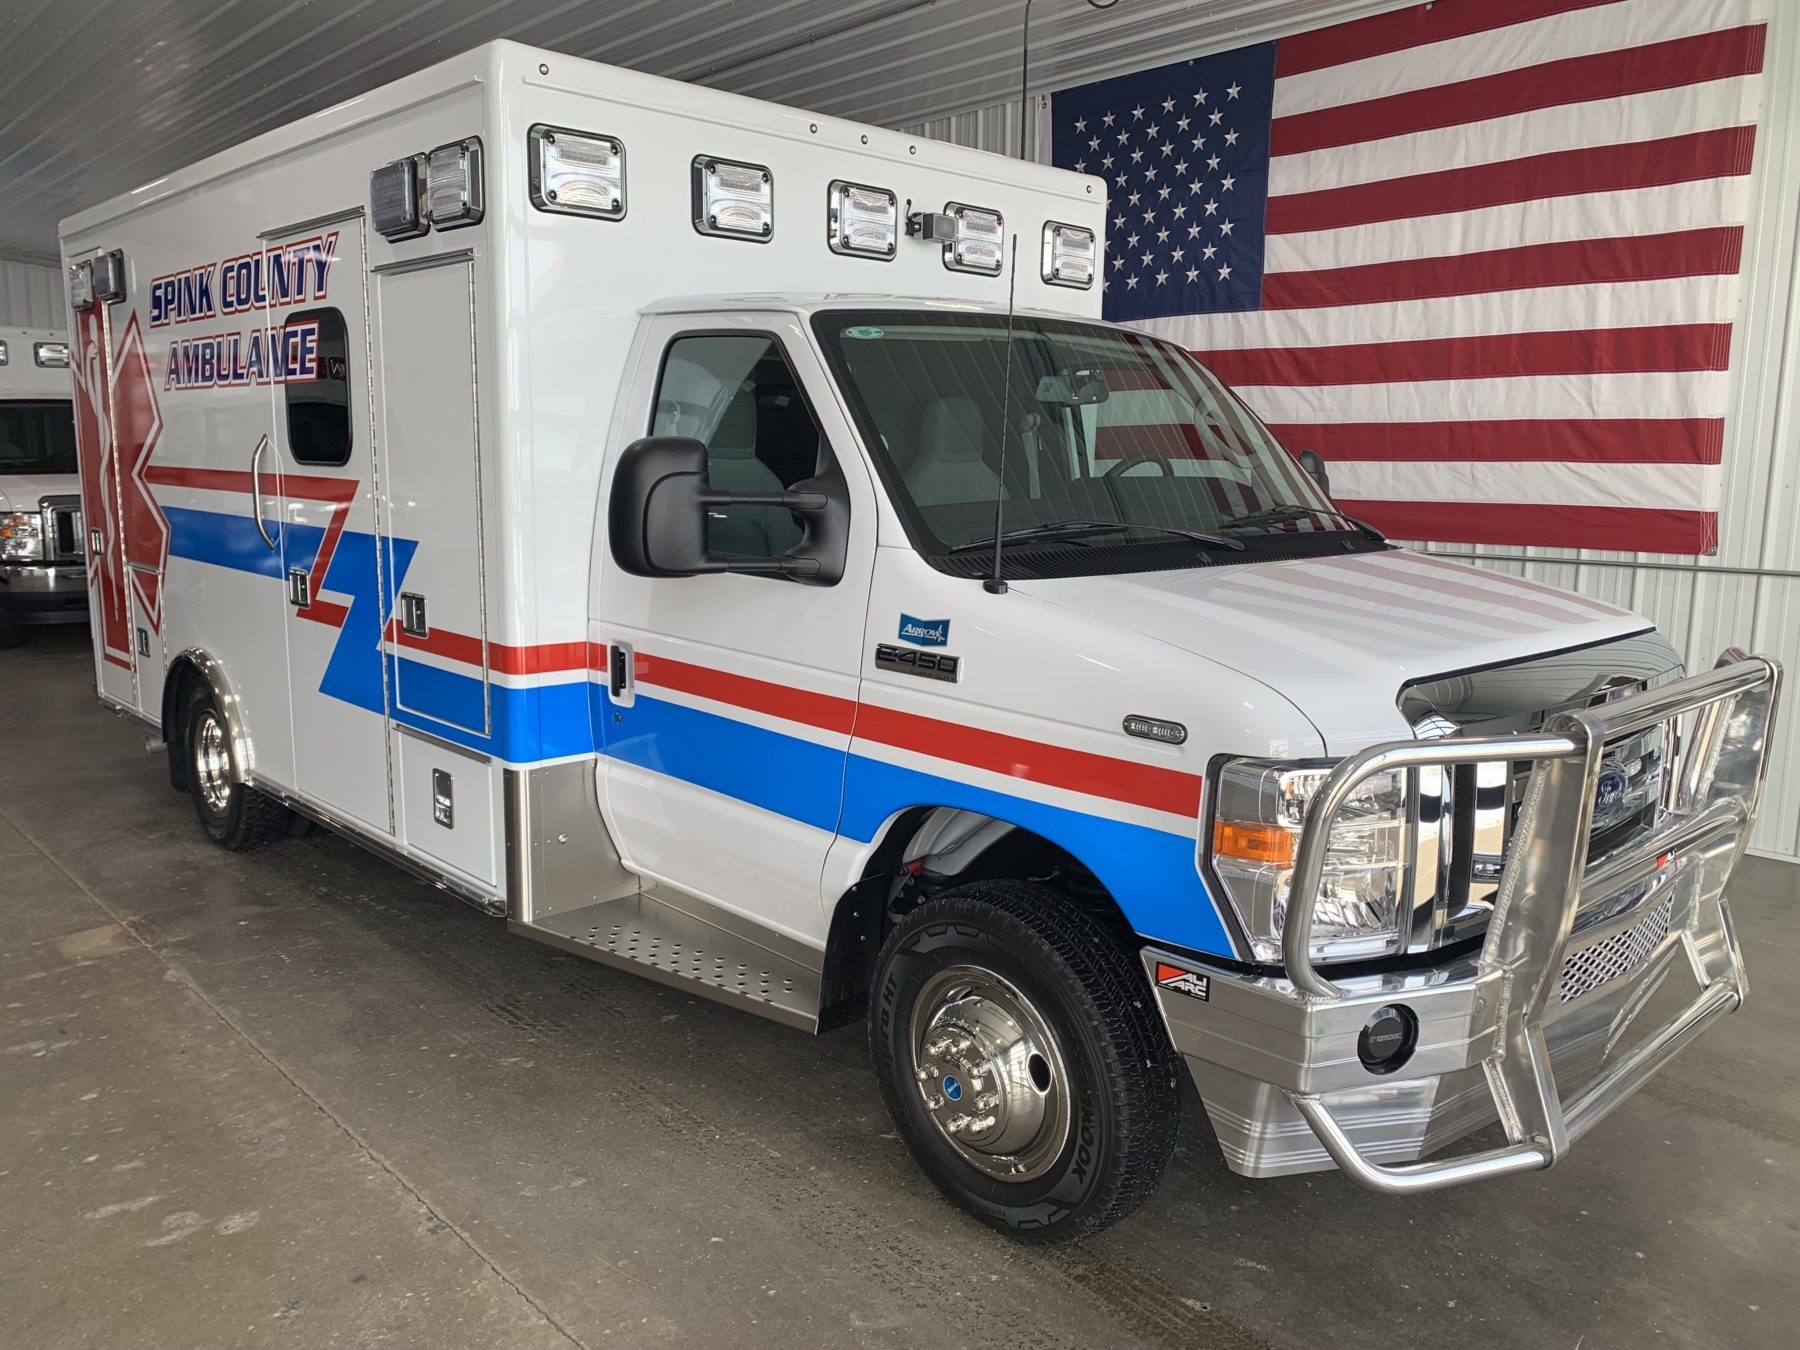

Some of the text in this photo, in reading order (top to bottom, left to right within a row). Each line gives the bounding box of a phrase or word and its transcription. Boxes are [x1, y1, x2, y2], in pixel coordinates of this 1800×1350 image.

[150, 231, 340, 329] SPINK COUNTY
[164, 319, 320, 391] AMBULANCE
[902, 623, 942, 638] ARROW
[1172, 973, 1207, 987] ALI
[1168, 981, 1206, 997] ARC
